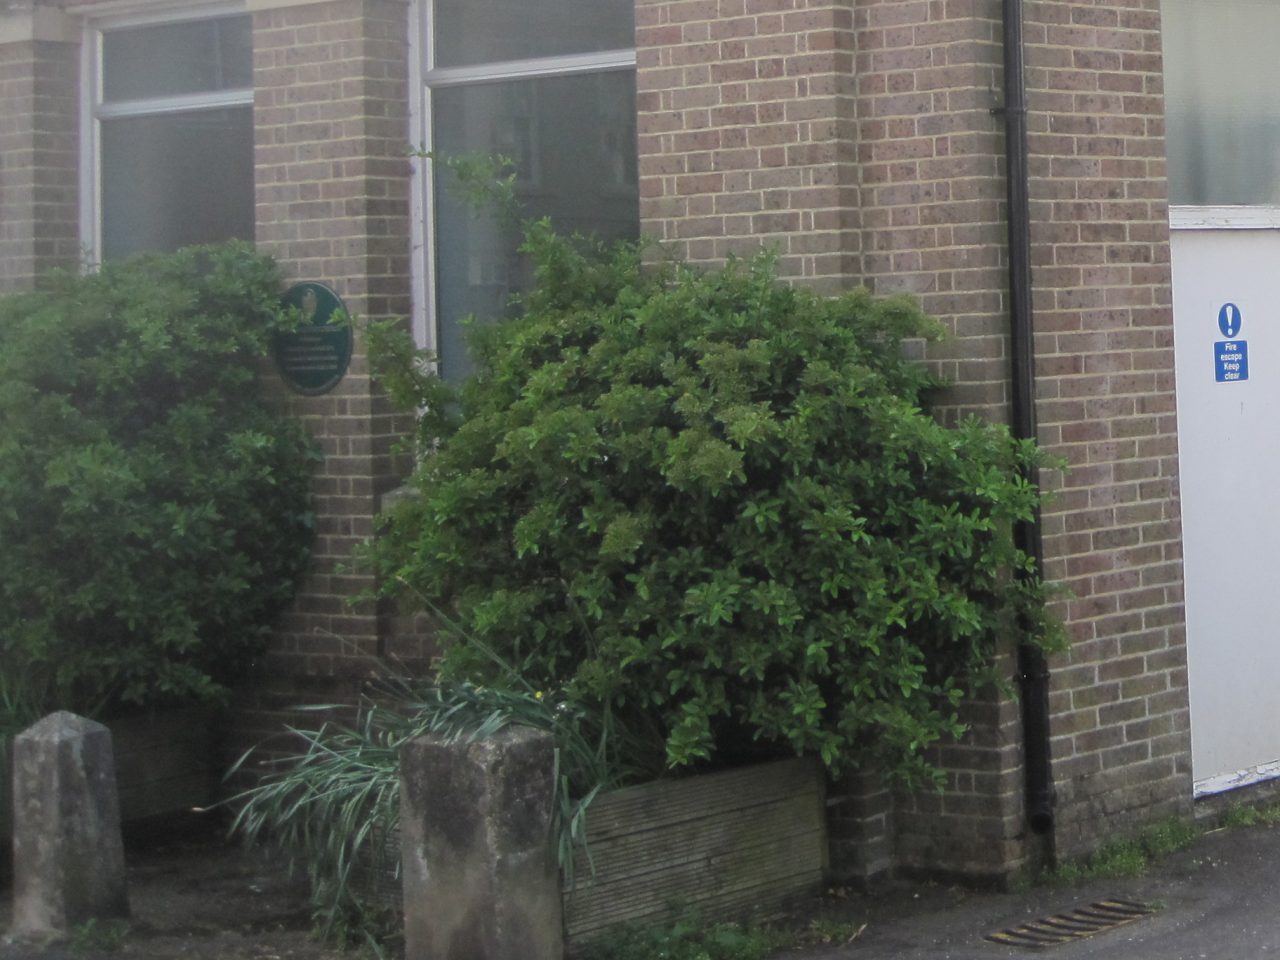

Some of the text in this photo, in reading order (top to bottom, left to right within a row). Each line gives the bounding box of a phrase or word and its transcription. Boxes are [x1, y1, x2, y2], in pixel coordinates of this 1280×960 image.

[1225, 343, 1237, 351] Fire
[1220, 353, 1242, 362] escape
[1223, 362, 1240, 372] Keep
[1224, 371, 1240, 380] clear
